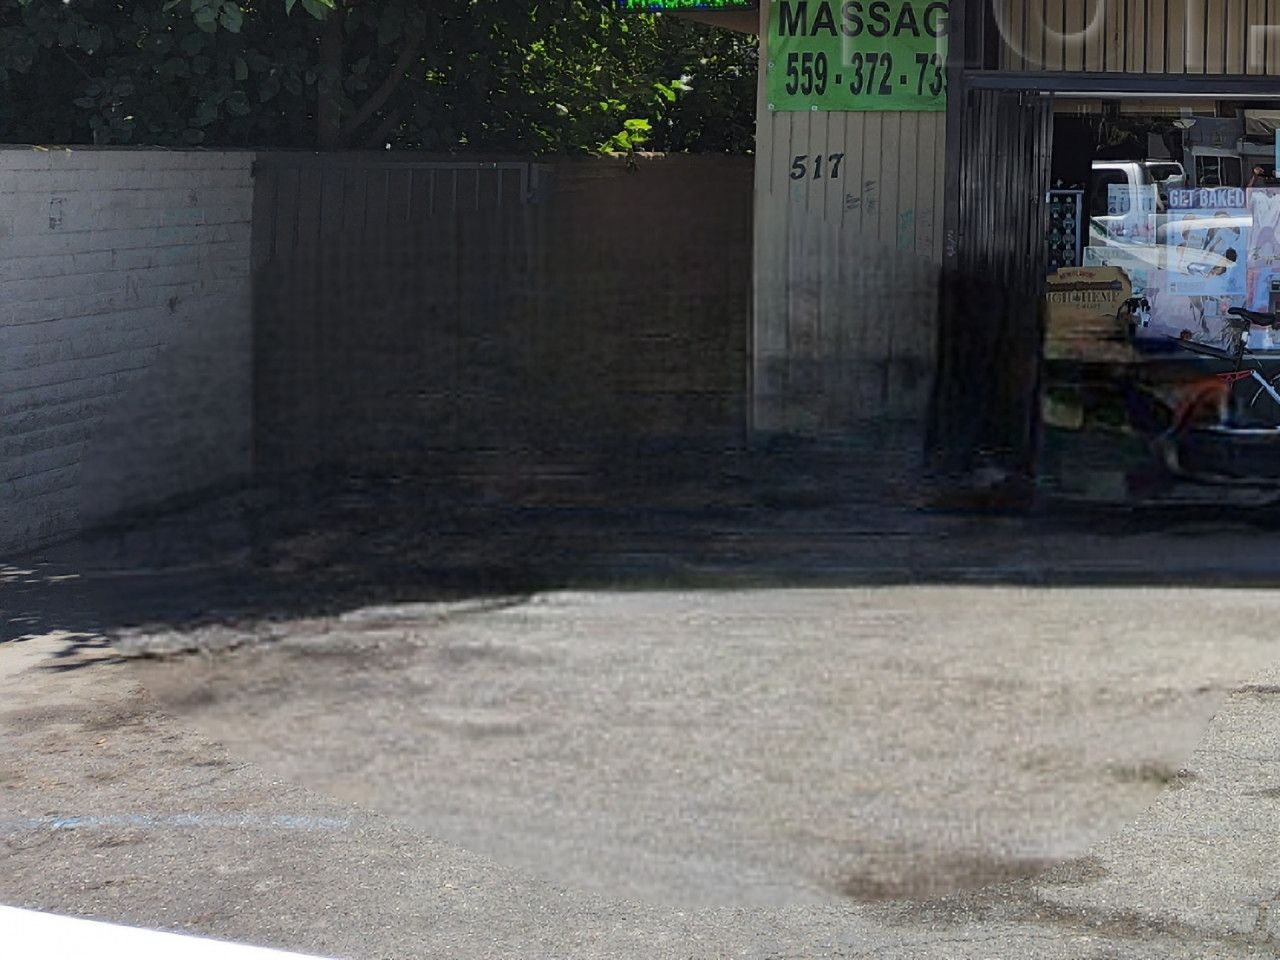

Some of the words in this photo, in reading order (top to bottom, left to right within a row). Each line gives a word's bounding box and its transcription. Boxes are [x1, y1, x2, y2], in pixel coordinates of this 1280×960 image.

[778, 0, 950, 38] MASSAG
[790, 153, 845, 180] 517
[1169, 189, 1195, 207] GET
[1200, 189, 1245, 207] BAKED
[1046, 291, 1071, 304] IGH
